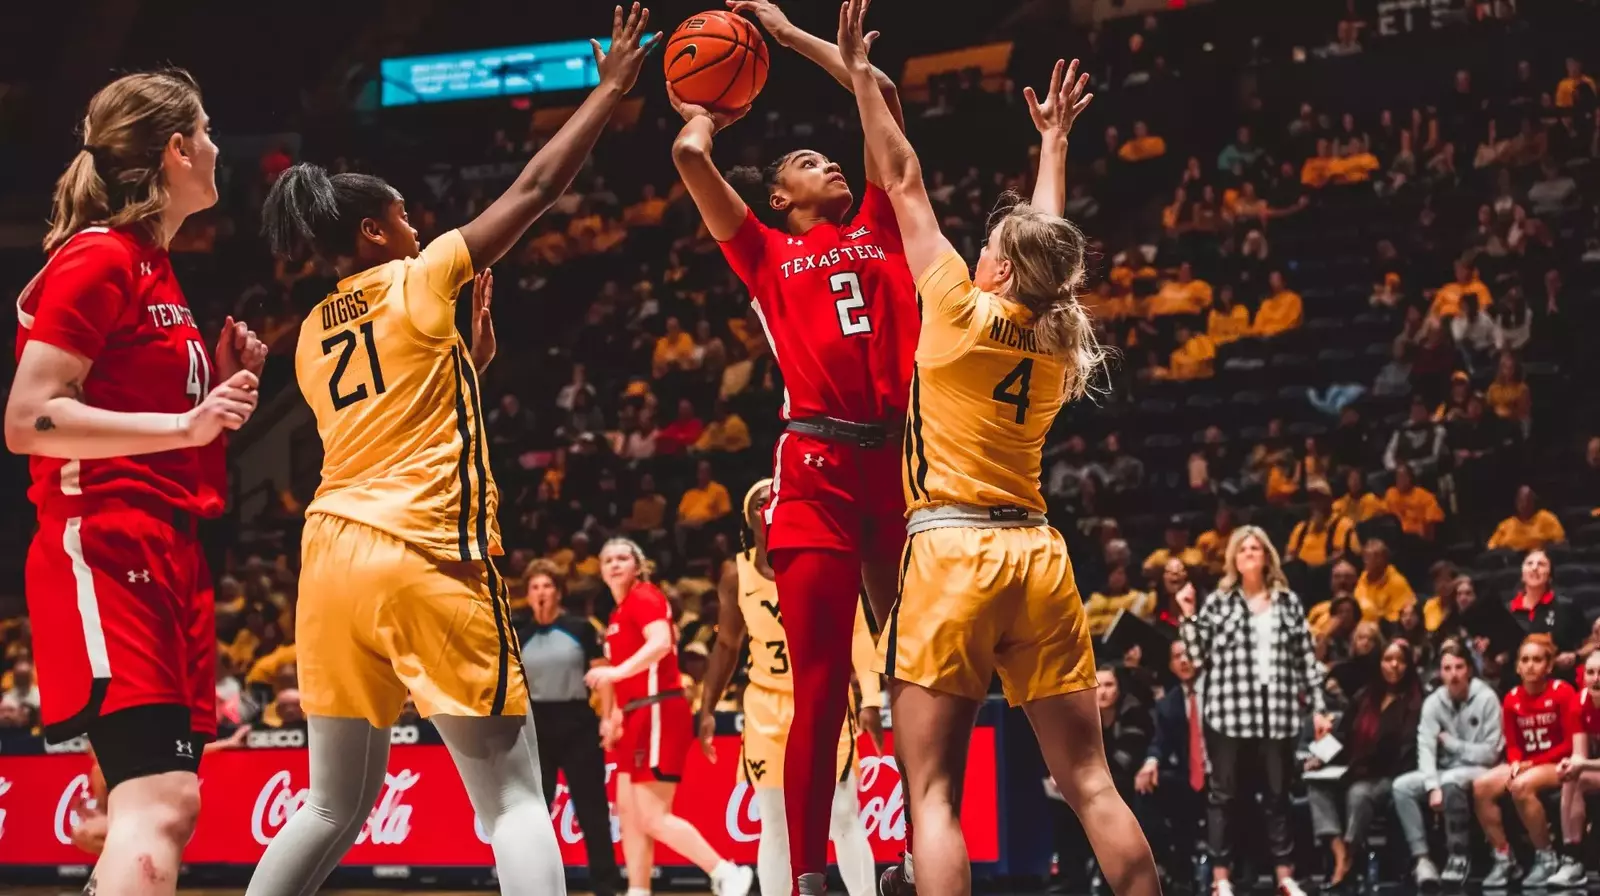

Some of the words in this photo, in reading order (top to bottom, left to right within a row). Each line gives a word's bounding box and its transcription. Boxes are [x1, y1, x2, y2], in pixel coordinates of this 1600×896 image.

[780, 247, 841, 279] TEXAS
[840, 244, 887, 261] TECH
[321, 289, 369, 331] DIGGS
[829, 271, 872, 337] 2
[186, 340, 210, 407] 41
[321, 320, 386, 412] 21
[992, 357, 1034, 425] 4
[766, 640, 789, 675] 3
